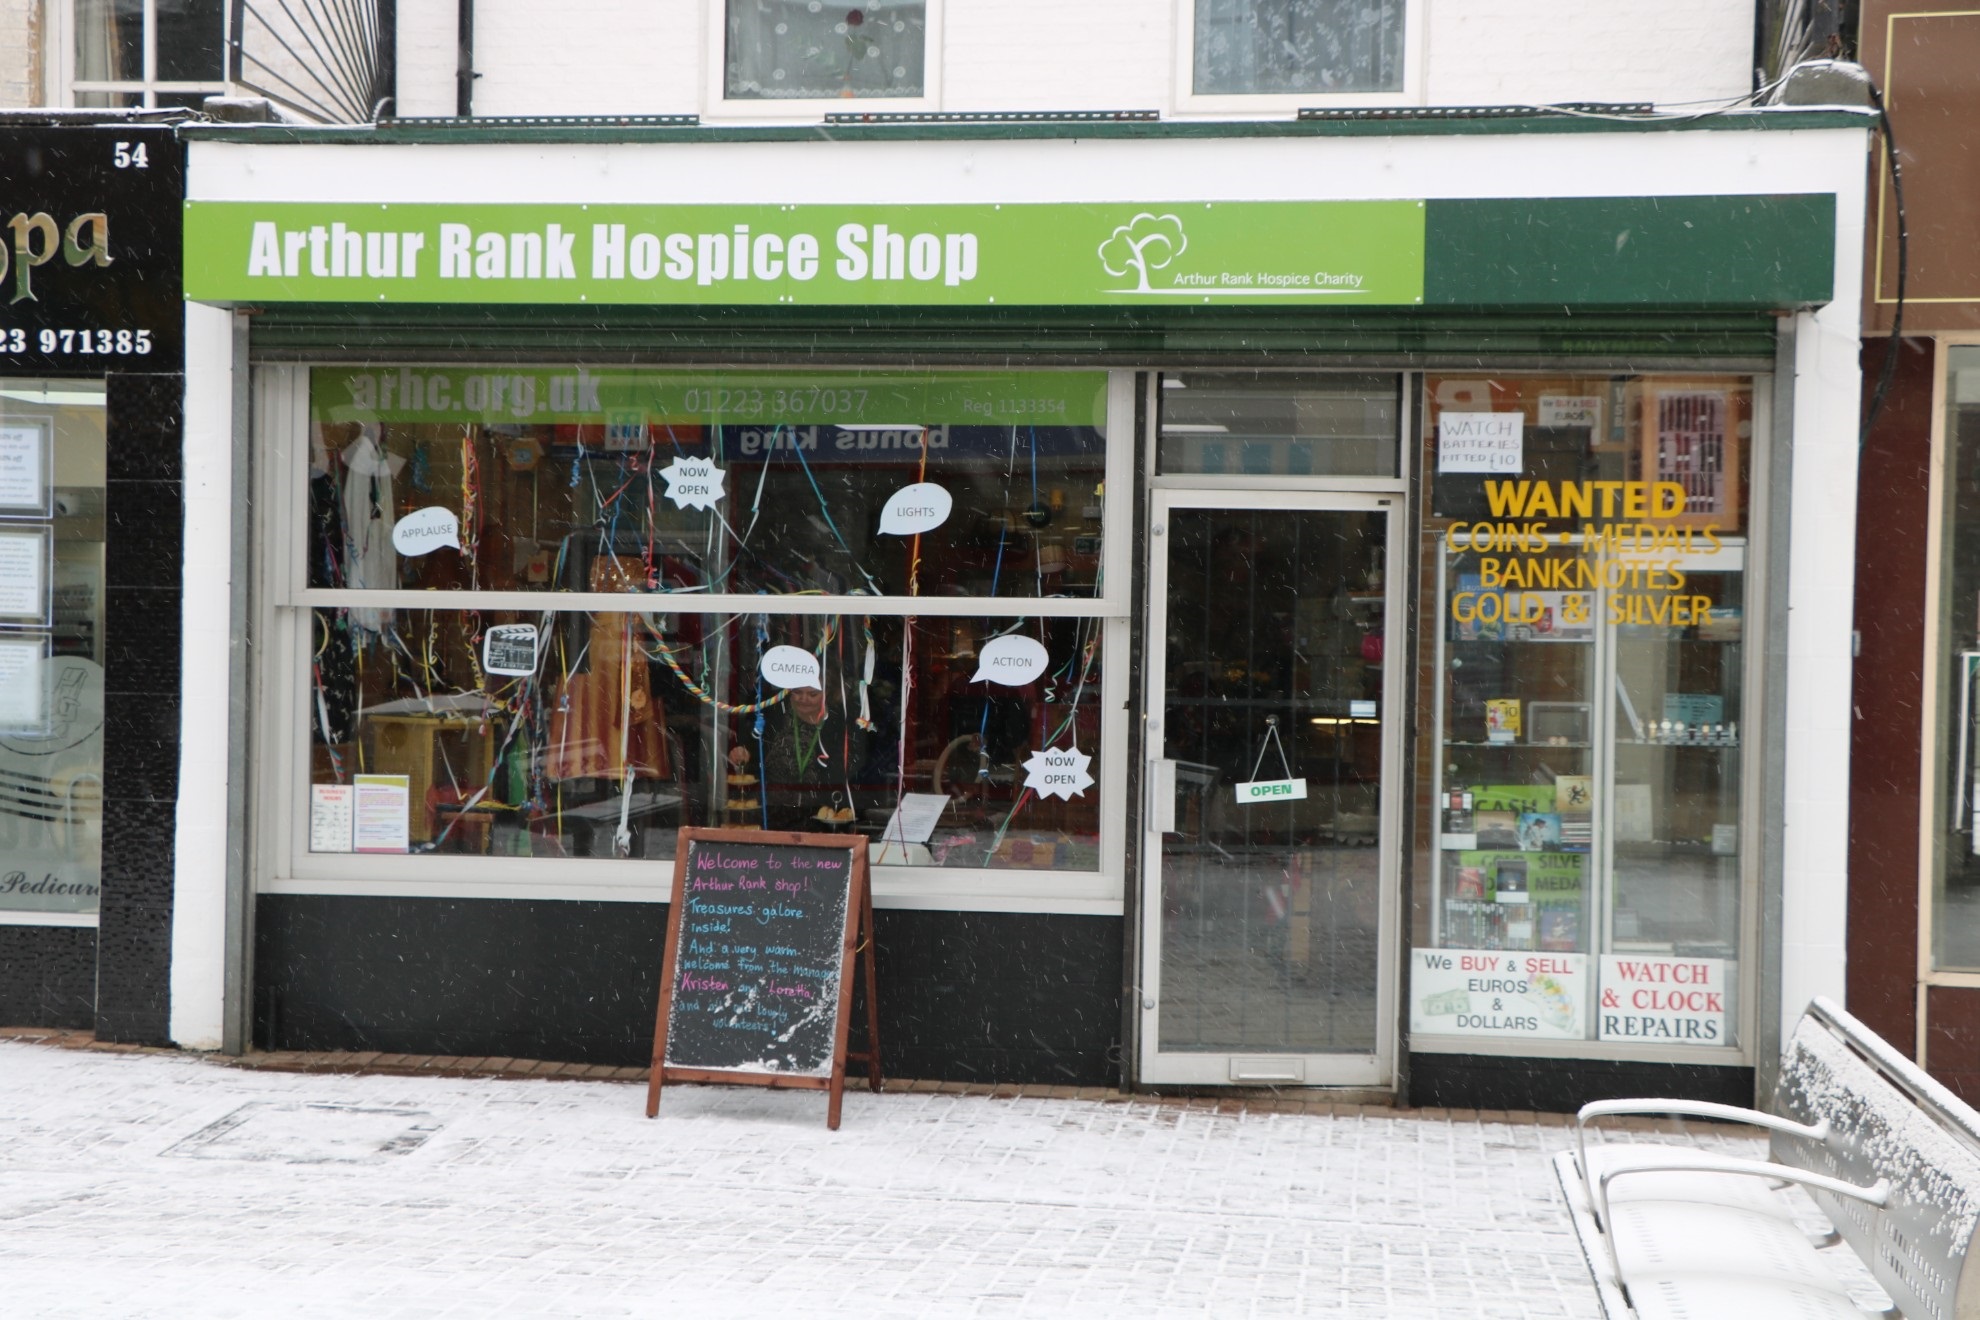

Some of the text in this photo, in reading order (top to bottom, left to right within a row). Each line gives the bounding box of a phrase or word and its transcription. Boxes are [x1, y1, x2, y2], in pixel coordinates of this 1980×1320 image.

[114, 141, 149, 168] 54
[247, 221, 979, 287] Arthur Rank Hospice Shop
[1173, 272, 1364, 288] Arthur Rank Hospice Charity
[39, 329, 152, 354] 971385
[351, 367, 603, 417] arhc.org.uk
[684, 388, 869, 414] 01223 367037
[963, 399, 1067, 417] Reg 1133354
[1443, 421, 1513, 437] WATCH
[1443, 439, 1520, 450] BATTERIES
[1442, 453, 1487, 463] FITTED
[679, 467, 709, 477] NOW
[678, 485, 709, 495] OPEN
[1484, 480, 1687, 518] WANTED
[897, 507, 936, 517] LIGHTS
[400, 523, 453, 539] APPLAUSE
[1445, 521, 1723, 555] COINS MEDALS
[1480, 557, 1687, 591] BANKNOTES
[1451, 592, 1713, 627] GOLD & SILVER
[770, 662, 815, 675] CAMERA
[992, 656, 1032, 668] ACTION
[1045, 756, 1076, 767] NOW
[1044, 774, 1076, 785] OPEN
[1250, 784, 1292, 797] OPEN
[697, 853, 843, 870] Welcome to the new
[1537, 855, 1582, 870] SILVE
[692, 875, 809, 899] Arthur Rank shop!
[1535, 877, 1582, 891] MEDA
[689, 897, 804, 925] Treasures galore
[691, 917, 731, 934] inside!
[688, 938, 798, 962] And a very warm
[683, 956, 730, 970] welcome
[737, 957, 764, 973] from
[769, 962, 789, 975] the
[1424, 954, 1574, 975] We BUY & SELL
[1616, 961, 1710, 985] WATCH
[681, 971, 812, 999] Kristen and Loretta
[1467, 978, 1528, 994] EUROS
[678, 1001, 700, 1012] and
[1492, 998, 1504, 1012] &
[1601, 988, 1724, 1013] & CLOCK
[1456, 1014, 1538, 1031] DOLLARS
[1603, 1014, 1719, 1040] REPAIRS
